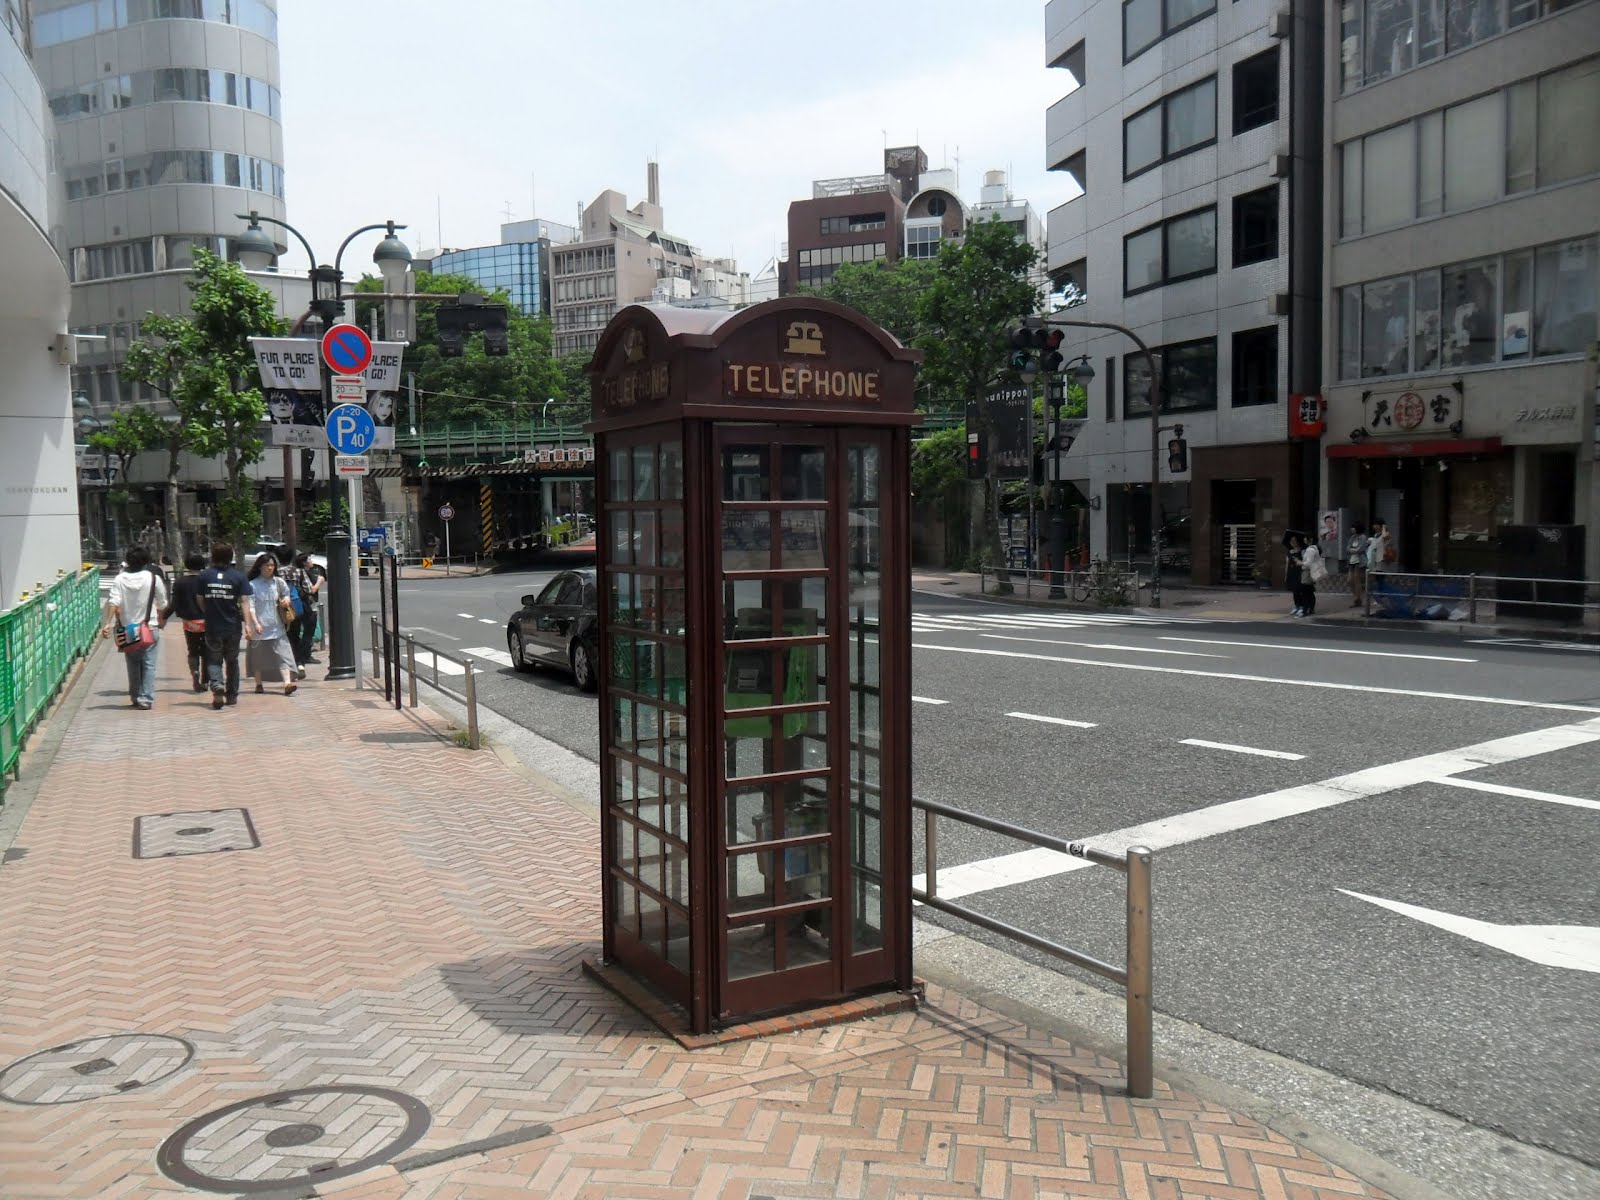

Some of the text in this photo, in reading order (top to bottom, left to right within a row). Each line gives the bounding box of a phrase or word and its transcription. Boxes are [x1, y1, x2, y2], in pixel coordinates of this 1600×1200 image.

[260, 352, 315, 365] FUN PLACE
[272, 366, 306, 379] TO GO!
[371, 368, 387, 380] GO!
[729, 364, 879, 399] TELEPHONE
[340, 408, 361, 416] 7-20
[337, 416, 365, 448] P 40
[360, 529, 370, 543] P
